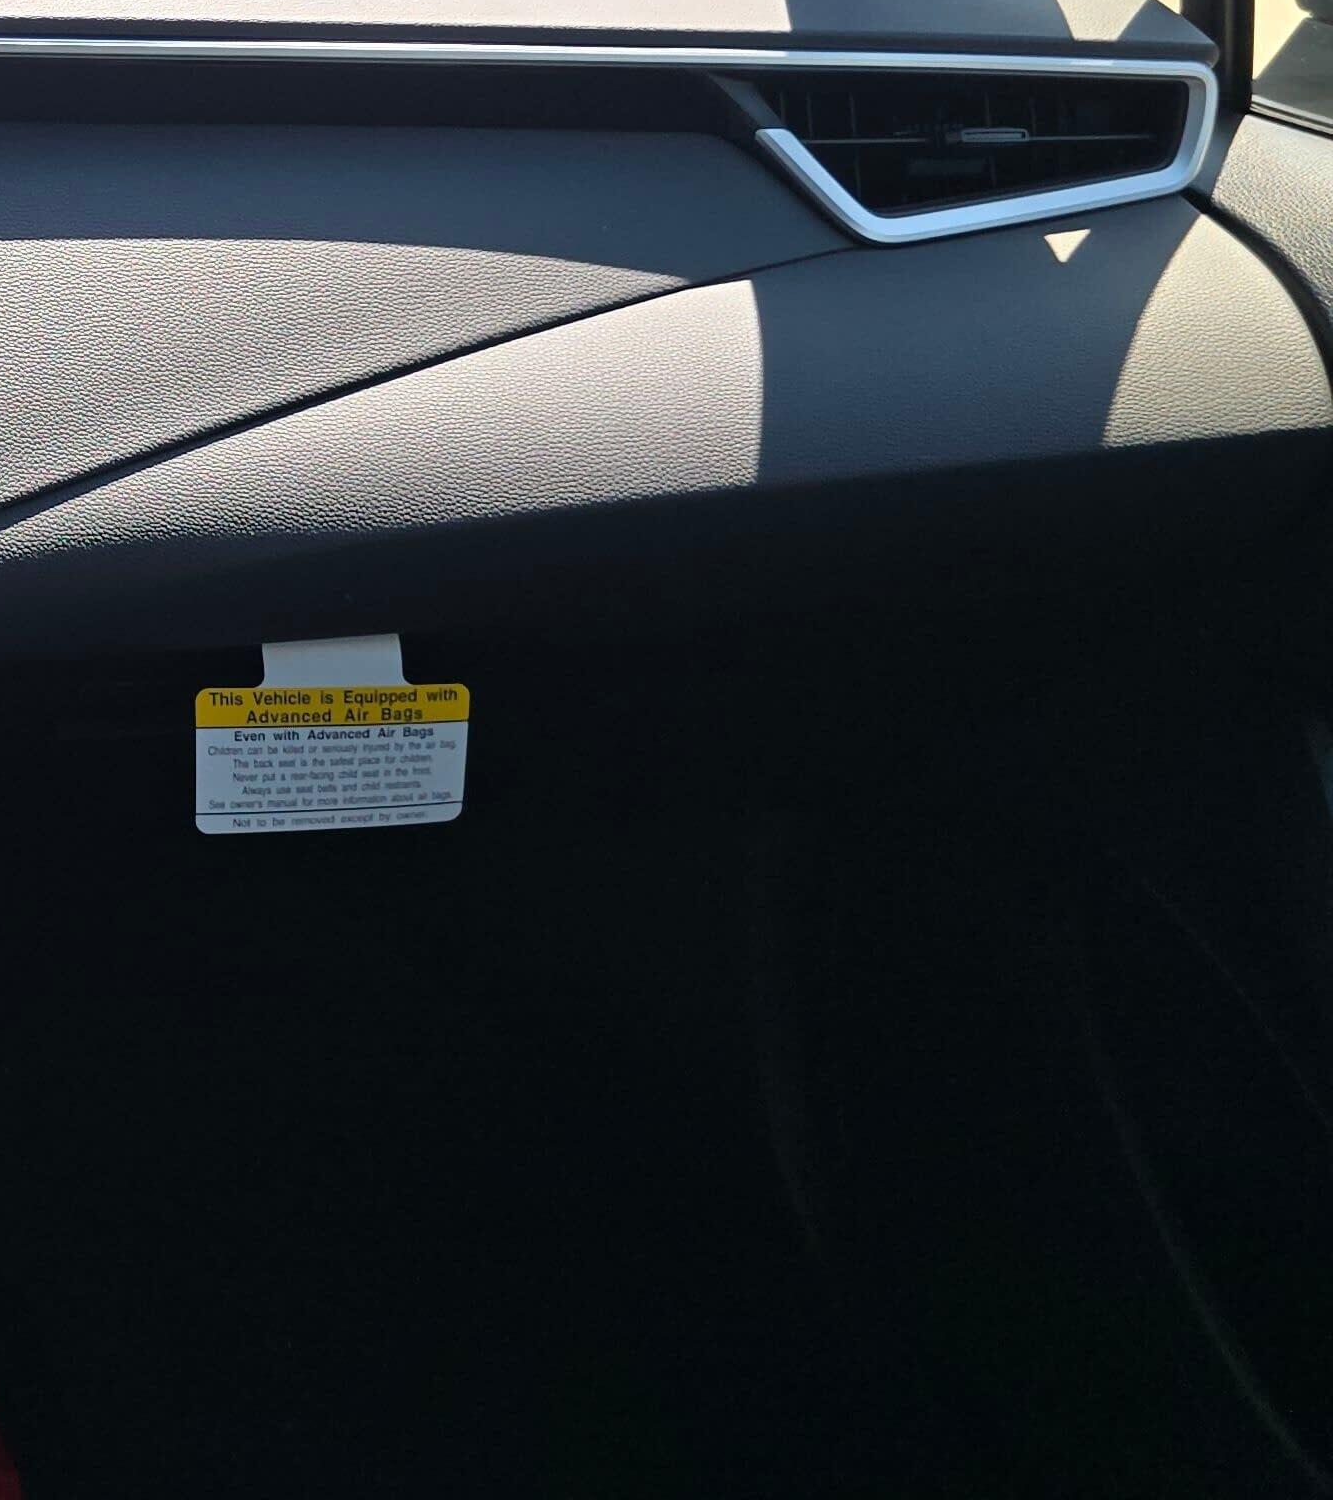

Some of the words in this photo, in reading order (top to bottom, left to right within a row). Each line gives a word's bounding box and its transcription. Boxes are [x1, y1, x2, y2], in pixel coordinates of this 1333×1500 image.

[208, 691, 243, 707] This
[253, 691, 312, 706] Vehicle
[319, 691, 334, 705] is
[343, 688, 418, 707] Equipped
[426, 688, 458, 702] with
[246, 709, 332, 724] Advanced
[344, 708, 369, 722] Air
[380, 706, 424, 723] Bags
[234, 731, 266, 742] Even
[273, 729, 300, 741] with
[307, 728, 370, 741] Advanced
[377, 727, 396, 739] Air
[402, 726, 434, 740] Bags
